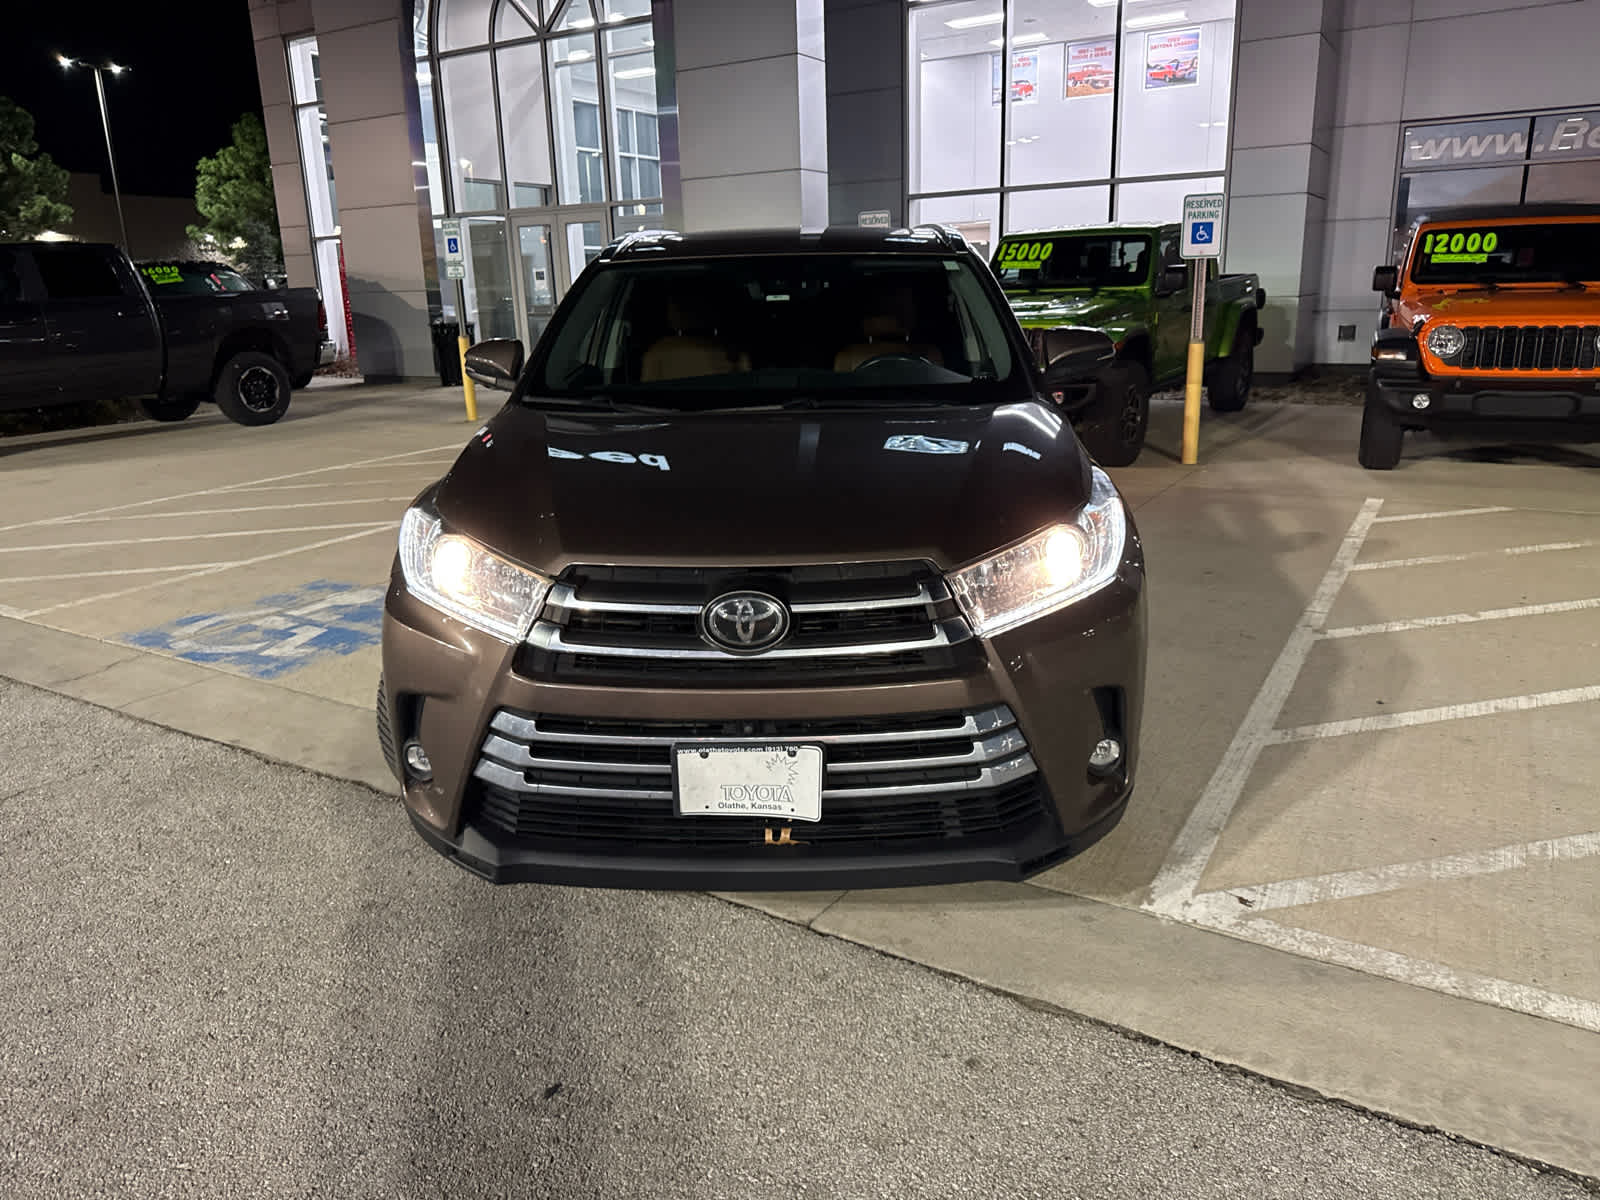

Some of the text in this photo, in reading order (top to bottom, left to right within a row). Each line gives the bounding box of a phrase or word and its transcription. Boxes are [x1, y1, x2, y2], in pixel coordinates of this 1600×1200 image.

[1186, 199, 1223, 209] RESERVED
[1187, 210, 1220, 220] PARKING
[1423, 232, 1498, 254] 12000
[997, 242, 1054, 261] 15000
[720, 784, 793, 802] TOYOTA
[718, 802, 782, 811] Olathe, Kansas
